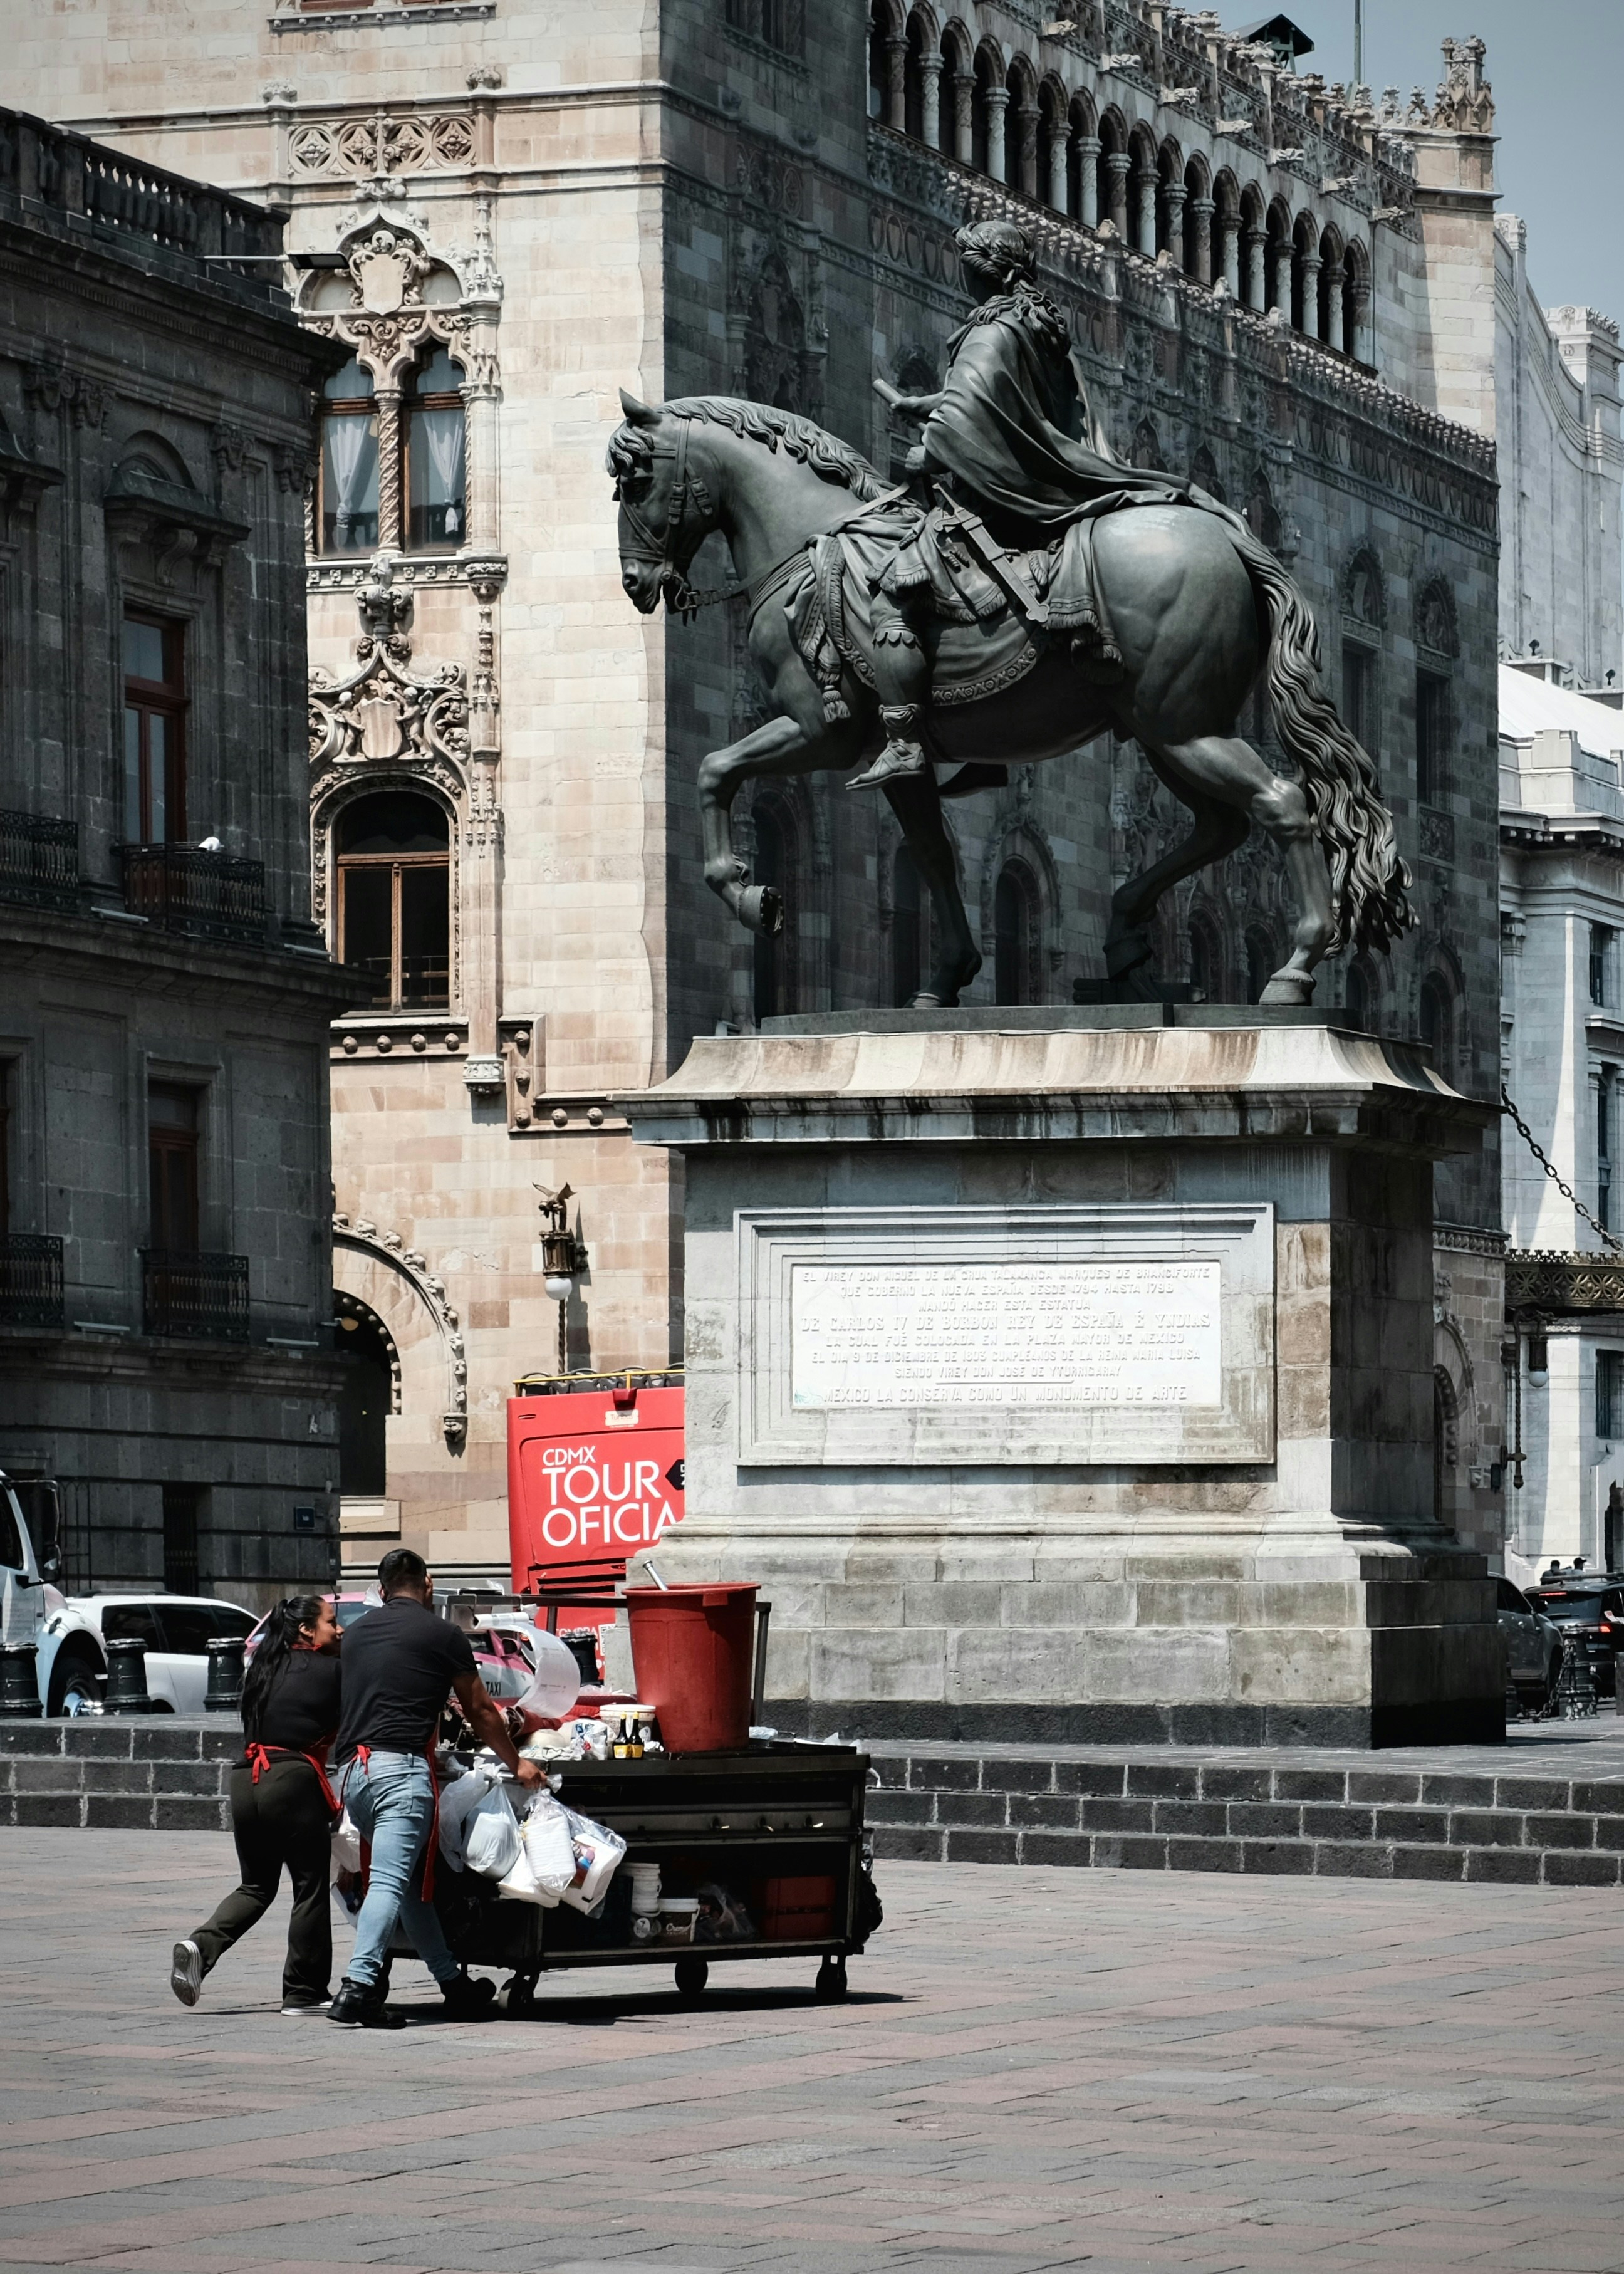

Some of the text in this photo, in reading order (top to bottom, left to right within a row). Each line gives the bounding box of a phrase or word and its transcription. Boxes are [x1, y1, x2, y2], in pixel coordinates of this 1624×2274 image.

[803, 1272, 816, 1282] EL
[824, 1271, 853, 1281] VIREY
[860, 1271, 879, 1281] DON
[925, 1271, 938, 1281] DE
[944, 1271, 956, 1281] LA
[1059, 1268, 1110, 1282] MARQUES
[1116, 1268, 1130, 1279] DE
[841, 1286, 860, 1298] QUE
[921, 1286, 935, 1296] LA
[942, 1285, 975, 1296] NUEVA
[1030, 1283, 1066, 1295] DESDE
[1072, 1283, 1098, 1294] 1794
[1105, 1283, 1140, 1293] HASTA
[1146, 1282, 1174, 1293] 1798
[962, 1301, 998, 1311] HACER
[1004, 1300, 1032, 1310] ESTA
[1039, 1299, 1090, 1310] ESTATUA
[801, 1317, 820, 1332] DE
[830, 1317, 885, 1331] CARLOS
[893, 1317, 907, 1330] IV
[917, 1316, 934, 1330] DE
[942, 1316, 997, 1330] BORBON
[1007, 1315, 1035, 1329] REY
[1044, 1315, 1063, 1328] DE
[1071, 1311, 1123, 1328] ESPAÑA
[1155, 1313, 1210, 1327] YNDIAS
[826, 1336, 841, 1347] LA
[848, 1335, 878, 1347] CUAL
[915, 1335, 975, 1346] COLOCADA
[982, 1334, 997, 1345] EN
[1004, 1334, 1020, 1346] LA
[1027, 1333, 1065, 1345] PLAZA
[1072, 1333, 1110, 1344] MAYOR
[1118, 1333, 1132, 1344] DE
[1140, 1332, 1185, 1343] MEXICO
[812, 1352, 825, 1364] EL
[831, 1352, 848, 1363] DIA
[865, 1351, 879, 1363] DE
[884, 1350, 939, 1362] DICIEMBRE
[945, 1350, 957, 1362] DE
[1061, 1350, 1074, 1361] DE
[1080, 1349, 1093, 1361] LA
[1098, 1348, 1127, 1360] REINA
[1169, 1348, 1200, 1360] LUISA
[895, 1367, 932, 1378] SIENDO
[939, 1367, 968, 1377] VIREY
[974, 1367, 993, 1377] DON
[1031, 1366, 1044, 1377] DE
[823, 1387, 870, 1402] MEXICO
[877, 1387, 893, 1402] LA
[900, 1387, 962, 1402] CONSERVA
[969, 1386, 1002, 1401] COMO
[1010, 1386, 1026, 1401] UN
[1036, 1385, 1118, 1401] MONUMENTO
[1125, 1386, 1143, 1400] DE
[1152, 1385, 1187, 1400] ARTE
[542, 1445, 596, 1466] CDMX
[541, 1460, 662, 1505] TOUR
[486, 1681, 501, 1696] TAXI
